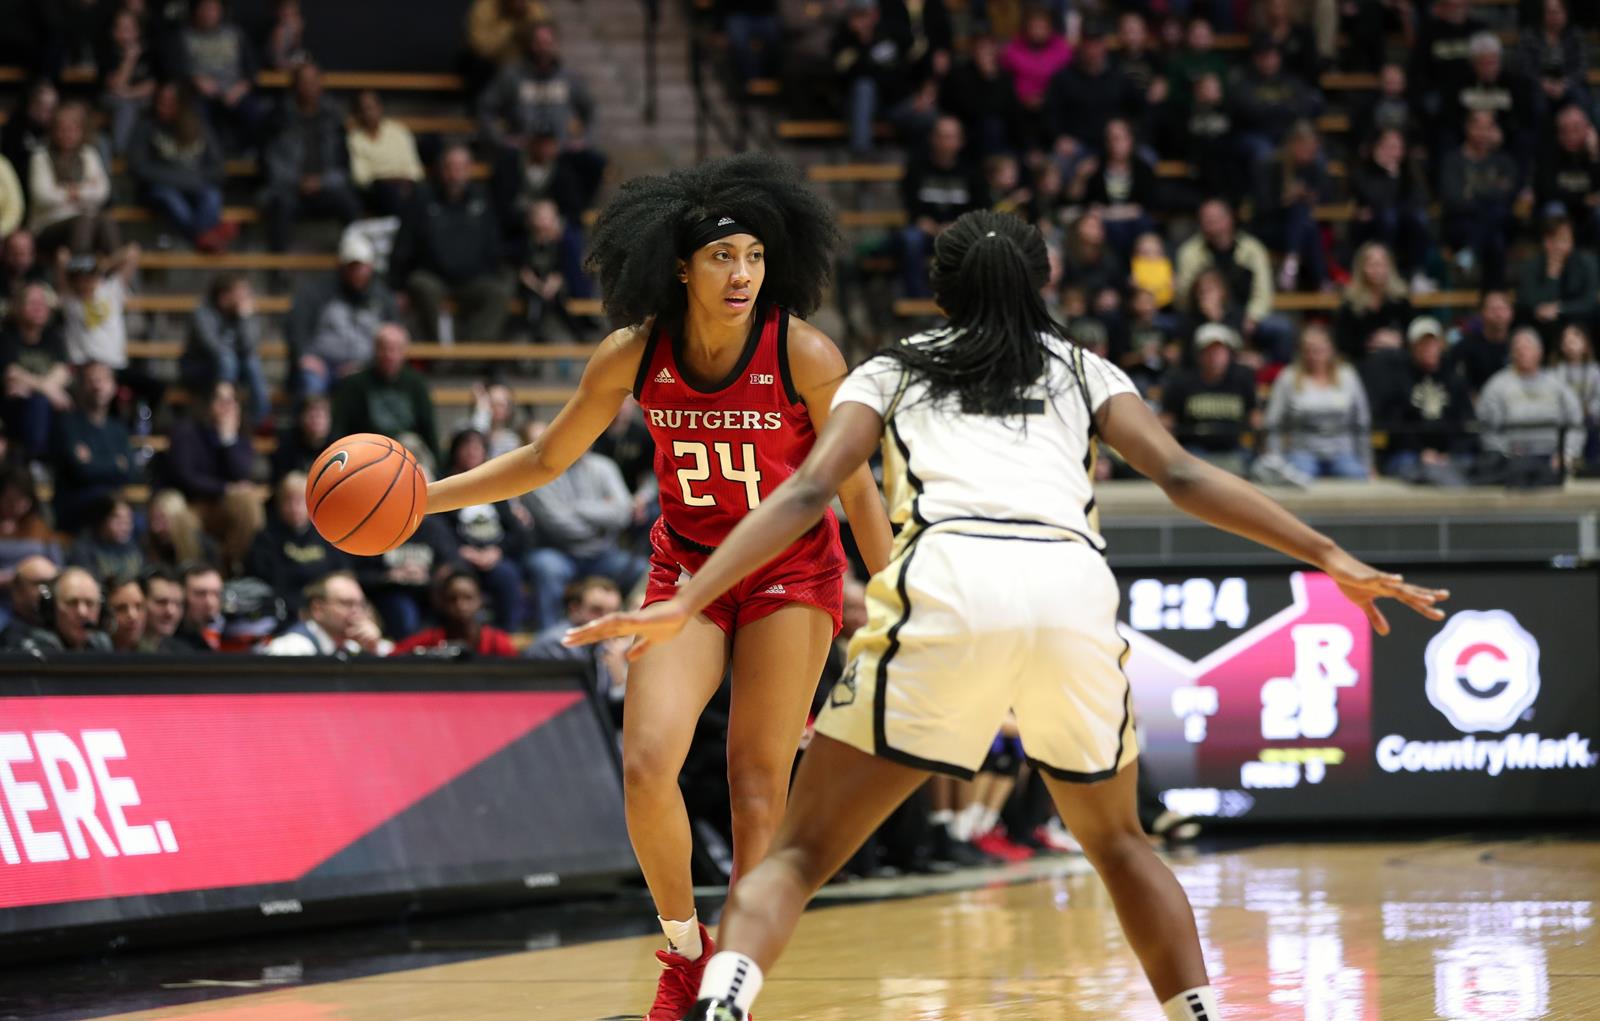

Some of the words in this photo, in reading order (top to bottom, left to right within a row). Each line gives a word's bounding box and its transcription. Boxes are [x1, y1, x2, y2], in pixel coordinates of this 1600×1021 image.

[649, 409, 782, 430] RUTGERS
[672, 440, 761, 510] 24
[1290, 623, 1359, 687] R
